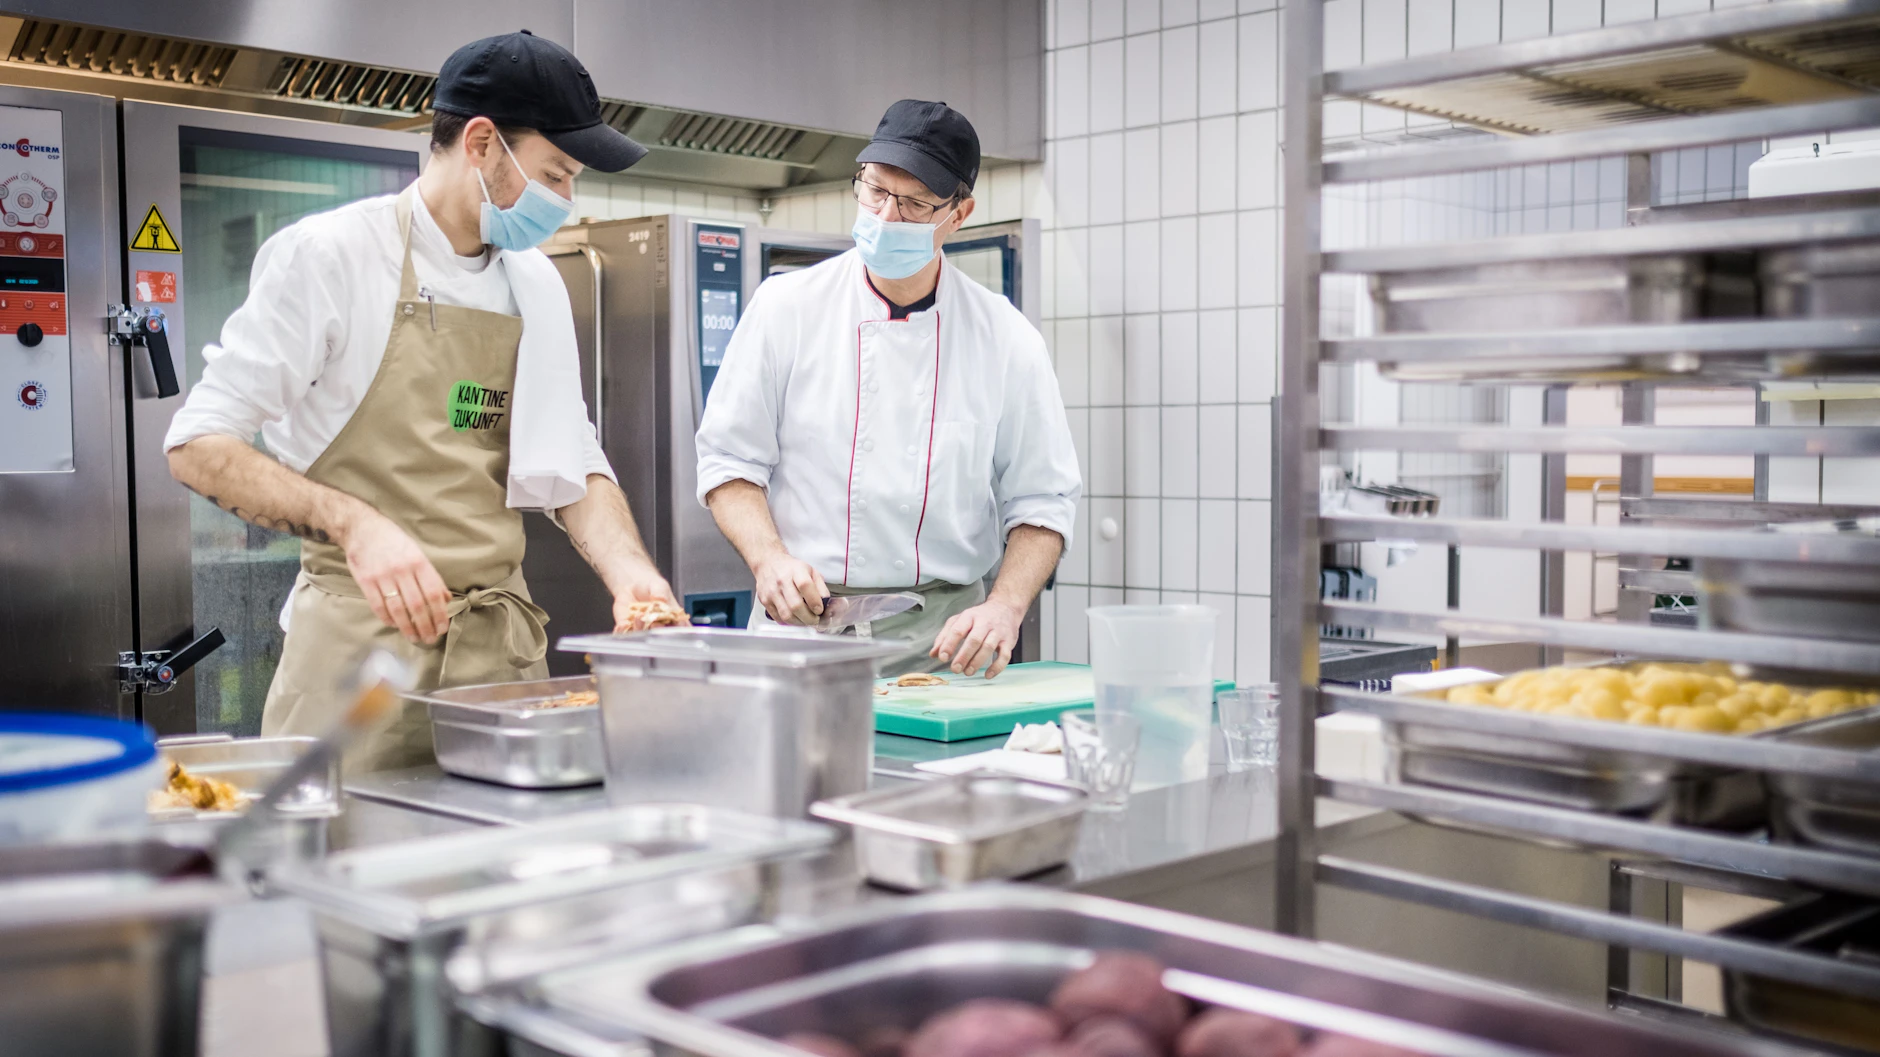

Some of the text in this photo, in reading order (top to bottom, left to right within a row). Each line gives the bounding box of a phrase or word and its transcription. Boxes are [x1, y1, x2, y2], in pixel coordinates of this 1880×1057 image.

[0, 142, 60, 154] ONVOTHERM
[703, 315, 734, 330] 00:00
[457, 385, 508, 408] KANTINE
[454, 409, 504, 430] ZUKUNFT
